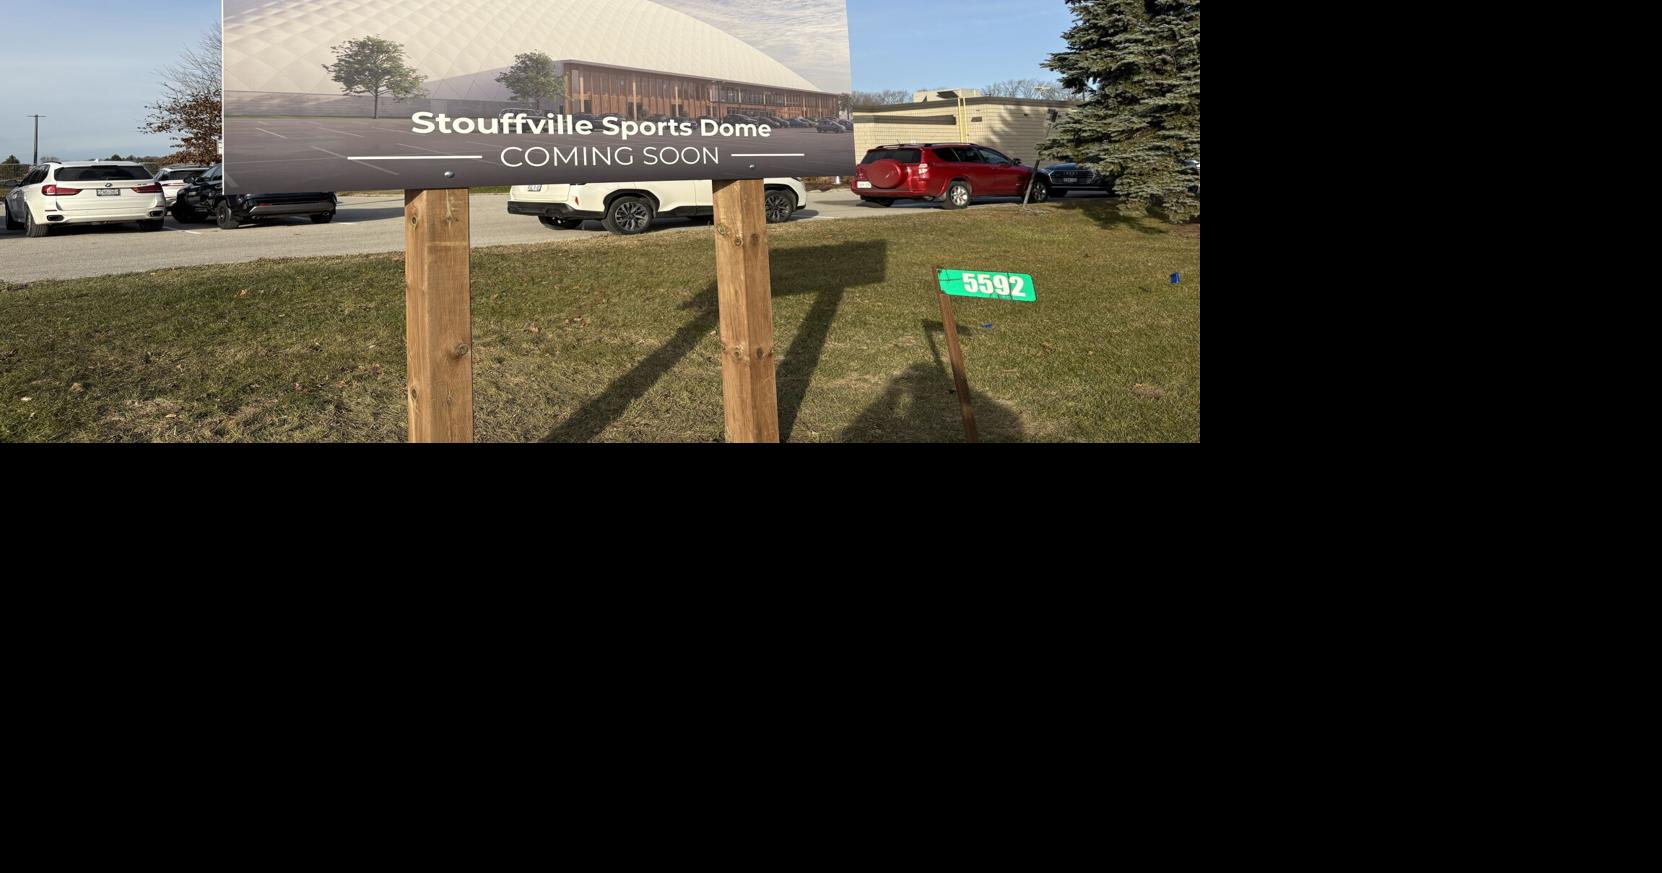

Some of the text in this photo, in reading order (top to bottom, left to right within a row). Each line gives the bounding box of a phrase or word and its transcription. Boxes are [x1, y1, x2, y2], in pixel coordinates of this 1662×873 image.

[411, 111, 772, 140] Stouffville Sports Dome
[500, 145, 719, 168] COMING SOON
[962, 272, 1026, 297] 5592
